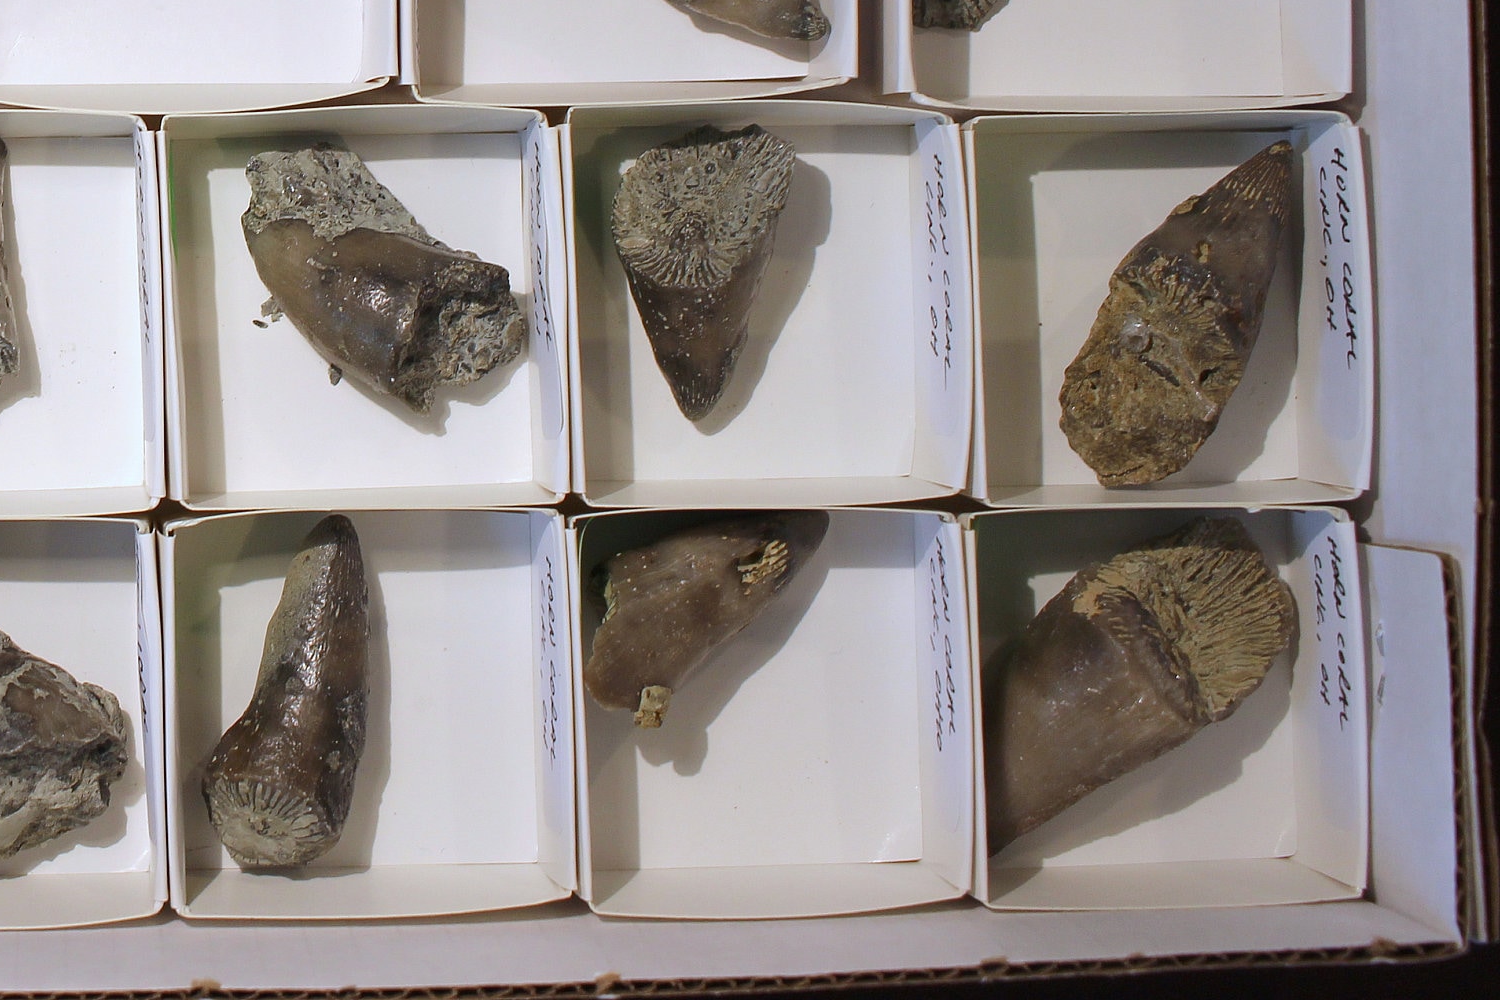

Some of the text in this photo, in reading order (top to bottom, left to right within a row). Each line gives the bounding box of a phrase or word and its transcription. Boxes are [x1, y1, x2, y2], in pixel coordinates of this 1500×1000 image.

[931, 305, 939, 359] OH
[933, 154, 954, 391] HORN CORAL
[1325, 276, 1337, 332] OH
[1330, 147, 1357, 370] HORN CORAL
[545, 555, 558, 770] HORN CORAL
[936, 536, 956, 737] HORN CORAL
[1319, 663, 1331, 706] OH
[1327, 535, 1351, 731] HORN CORAL
